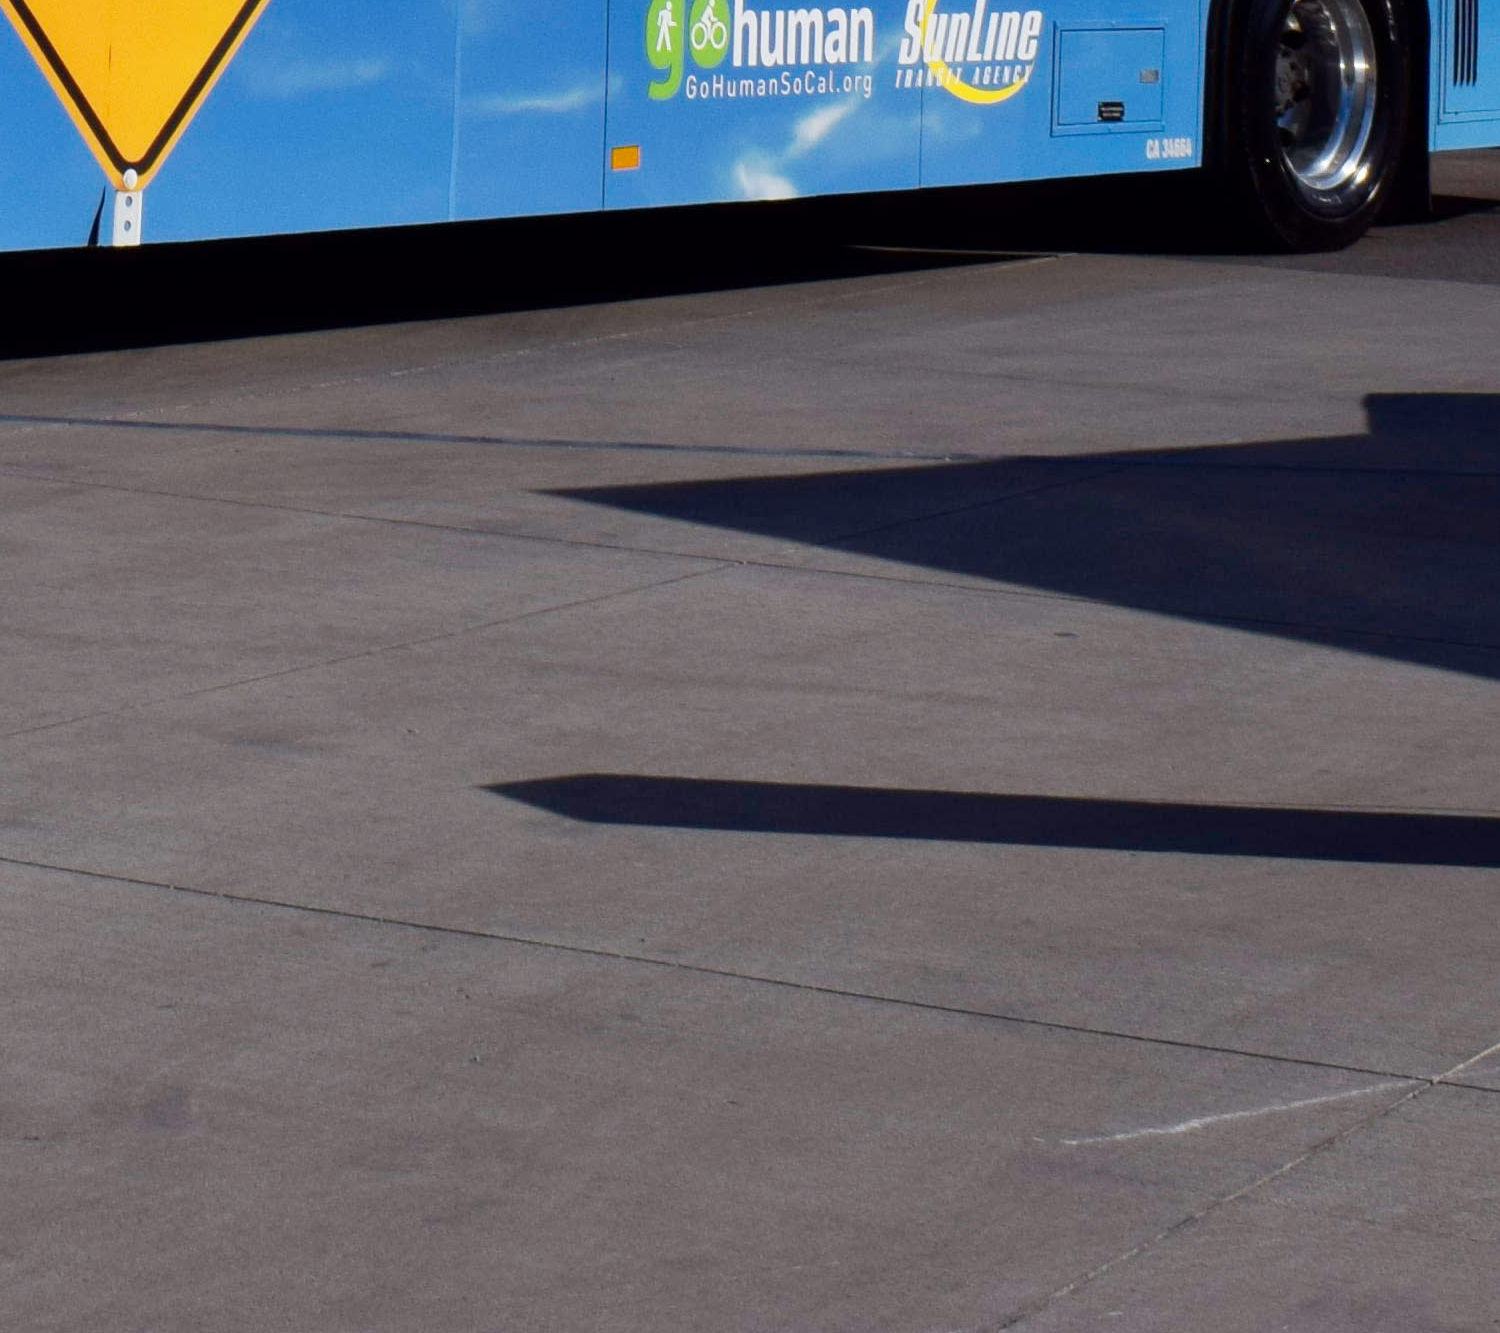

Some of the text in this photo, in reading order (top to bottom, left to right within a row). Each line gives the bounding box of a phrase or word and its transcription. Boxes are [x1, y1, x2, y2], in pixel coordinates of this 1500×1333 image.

[686, 70, 873, 99] GoHumanSoCal.org
[895, 64, 1035, 88] TRANSIT AGENCY
